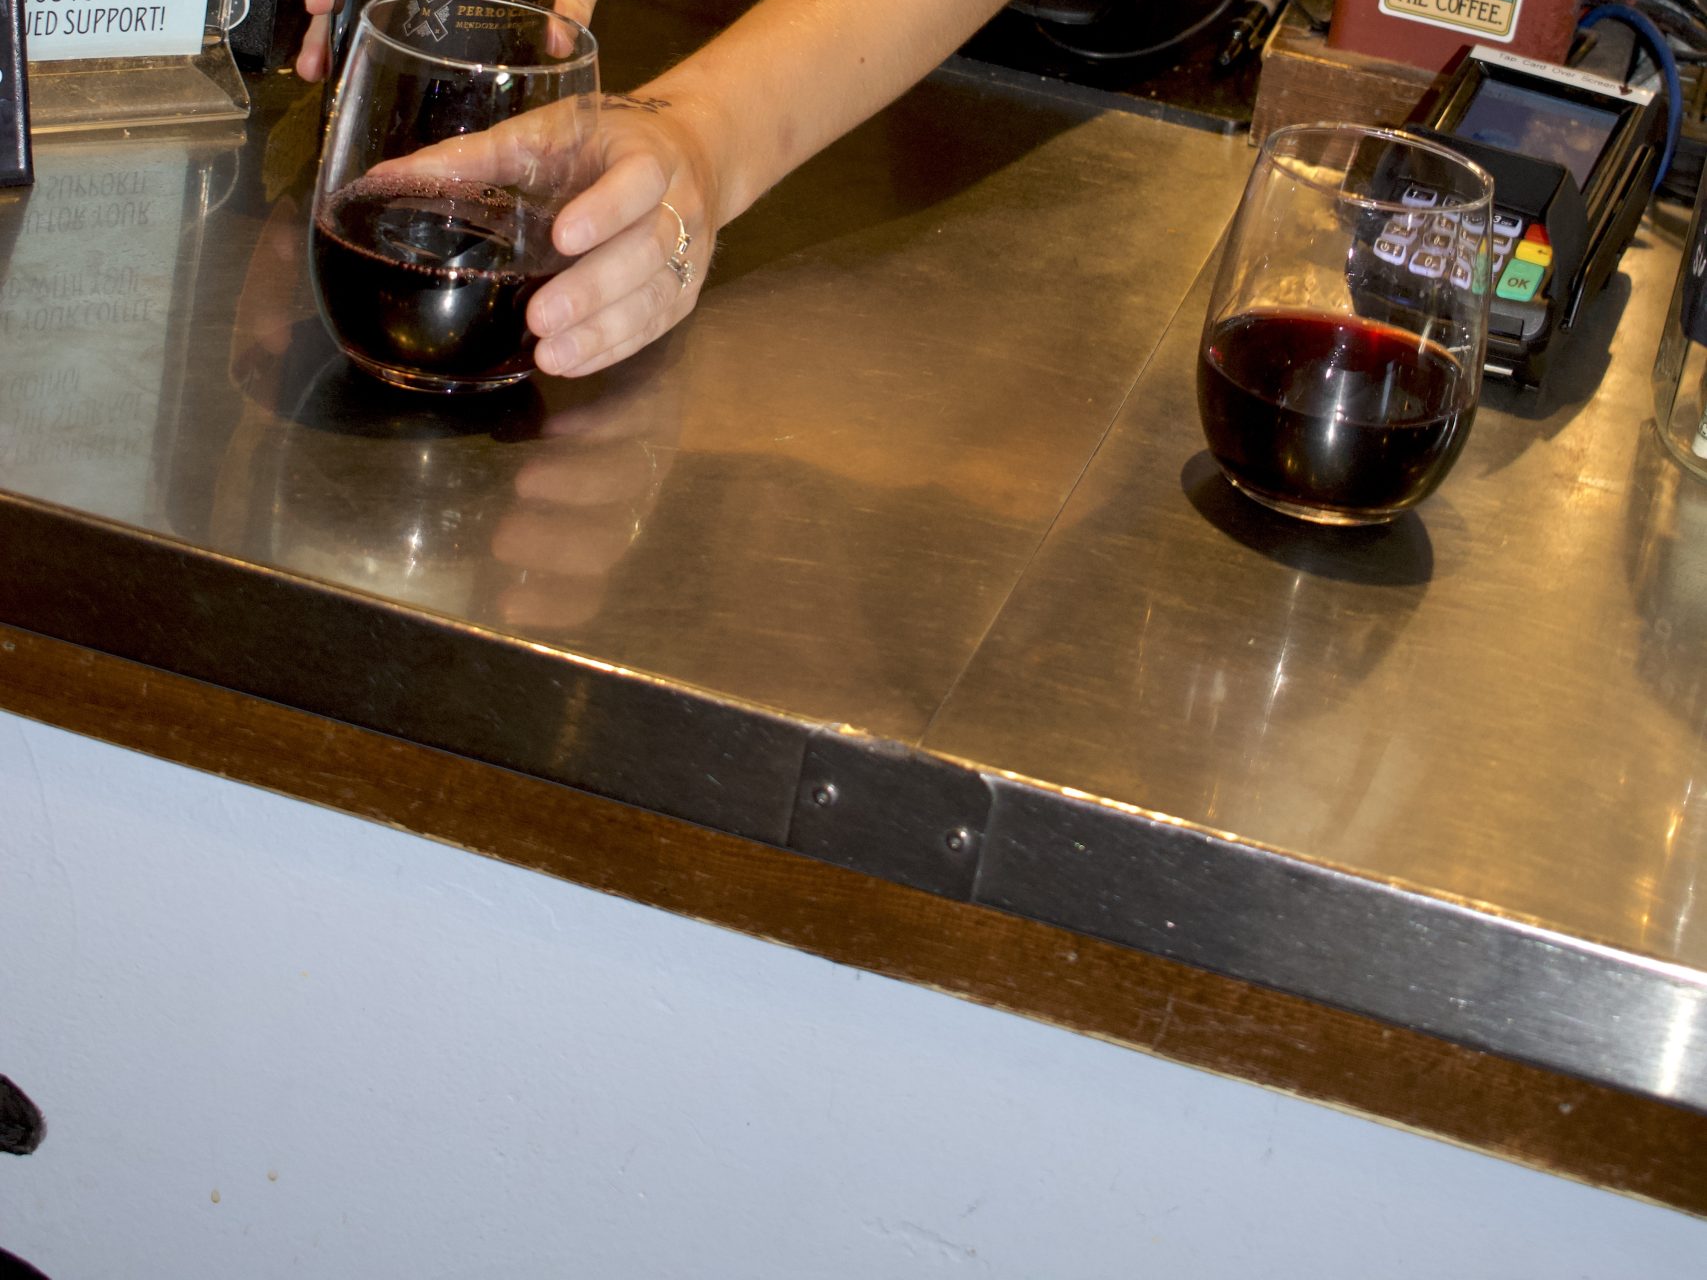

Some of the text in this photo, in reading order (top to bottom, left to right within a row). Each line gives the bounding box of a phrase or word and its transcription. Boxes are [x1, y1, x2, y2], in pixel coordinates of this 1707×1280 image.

[457, 5, 506, 18] PERRO
[63, 6, 166, 35] SUPPORT!
[1507, 276, 1530, 290] OK
